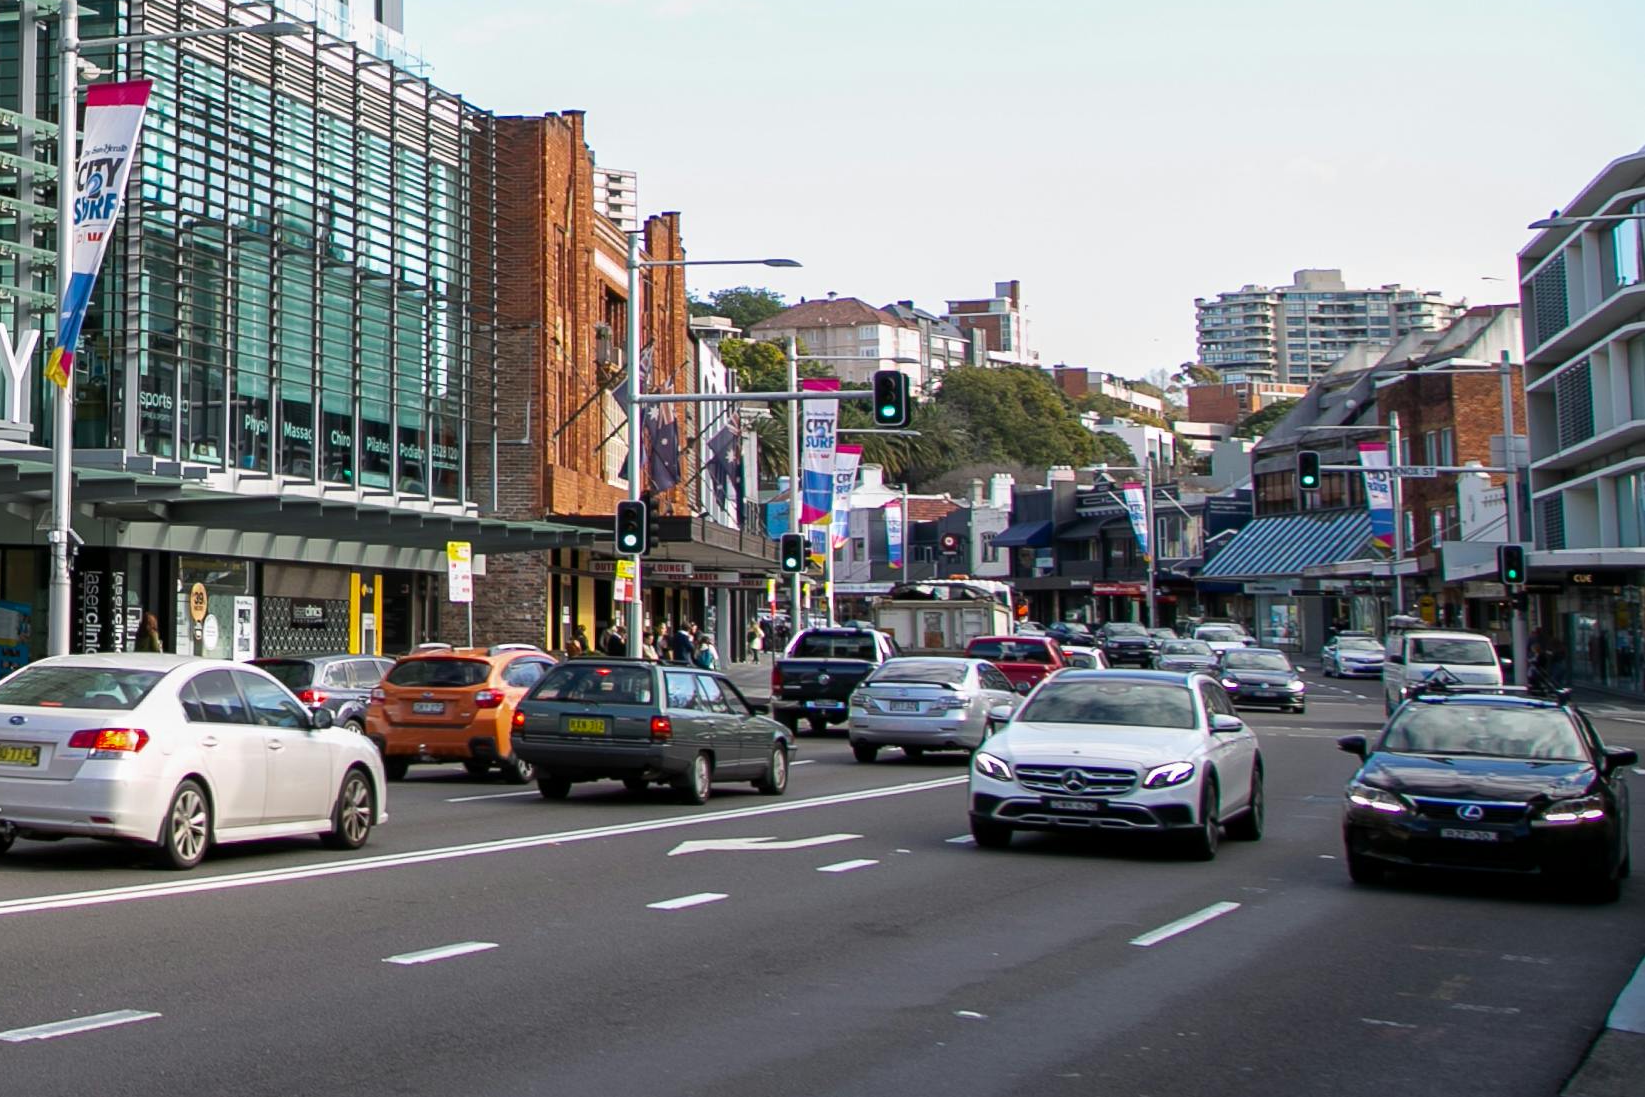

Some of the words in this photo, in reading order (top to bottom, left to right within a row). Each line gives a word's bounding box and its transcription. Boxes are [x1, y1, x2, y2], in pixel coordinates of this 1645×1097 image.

[77, 157, 124, 192] CITY
[74, 193, 117, 225] SURF
[331, 430, 352, 448] Chiro
[366, 436, 390, 455] Pilates
[1573, 574, 1594, 583] CUE
